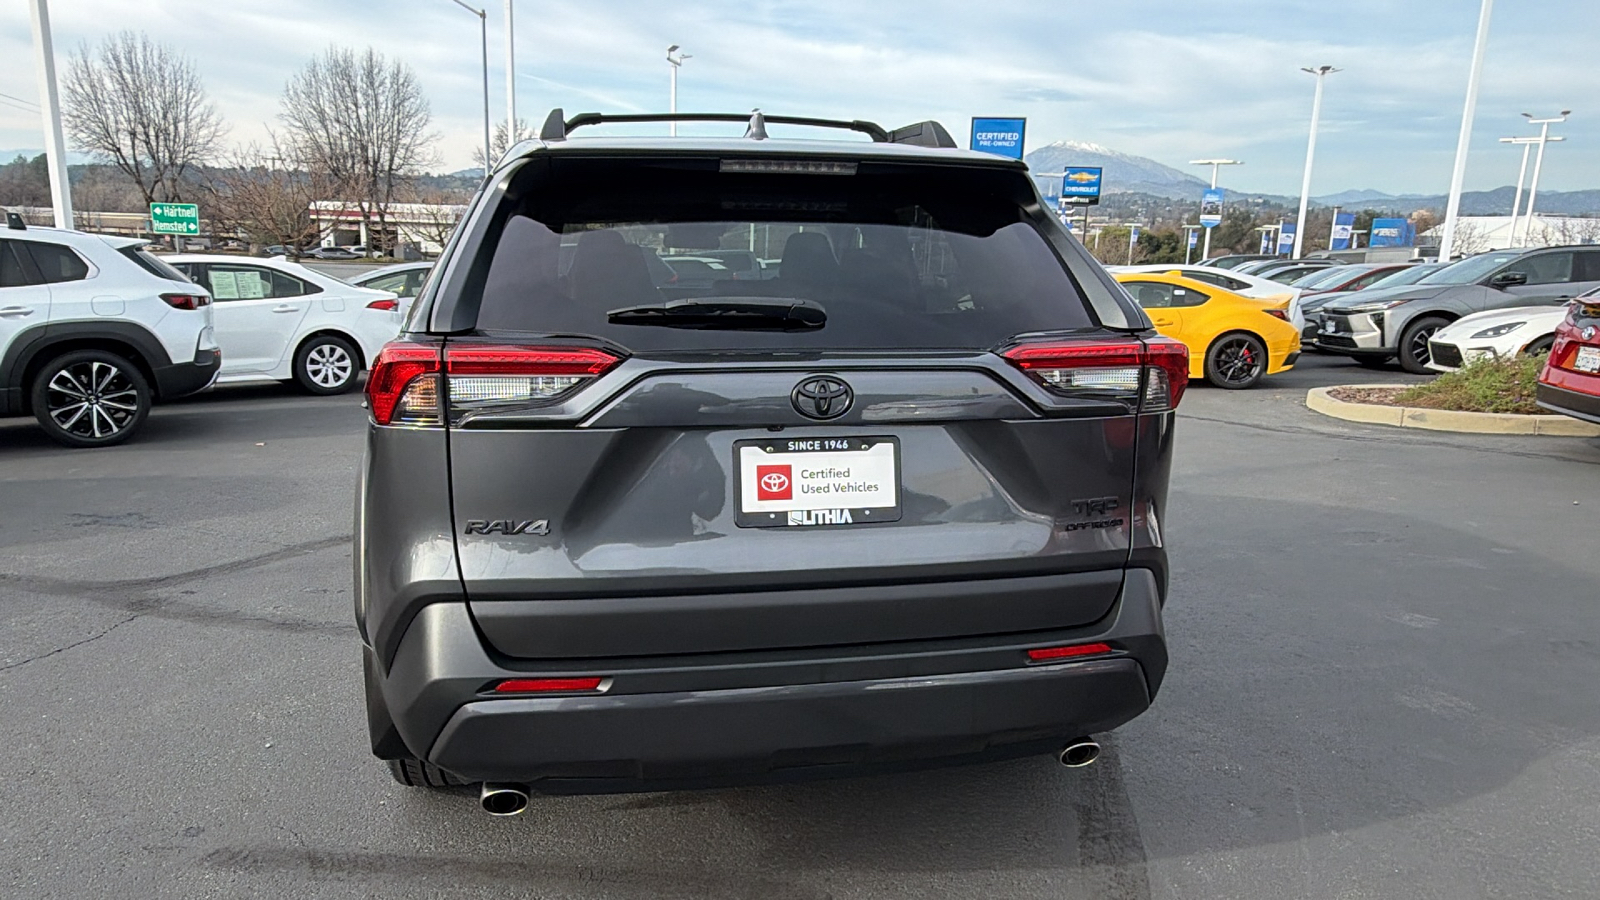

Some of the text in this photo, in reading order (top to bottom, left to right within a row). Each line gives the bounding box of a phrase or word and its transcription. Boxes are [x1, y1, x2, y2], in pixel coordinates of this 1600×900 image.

[976, 132, 1019, 140] CERTIFIED
[163, 206, 196, 217] Hartnell
[154, 220, 187, 232] Hemsted
[788, 440, 849, 451] SINCE 1946
[801, 468, 850, 479] Certified
[801, 481, 879, 494] Used Vehicles
[1070, 496, 1119, 516] TRD
[802, 508, 853, 525] LITHIA
[464, 519, 551, 536] RAV4
